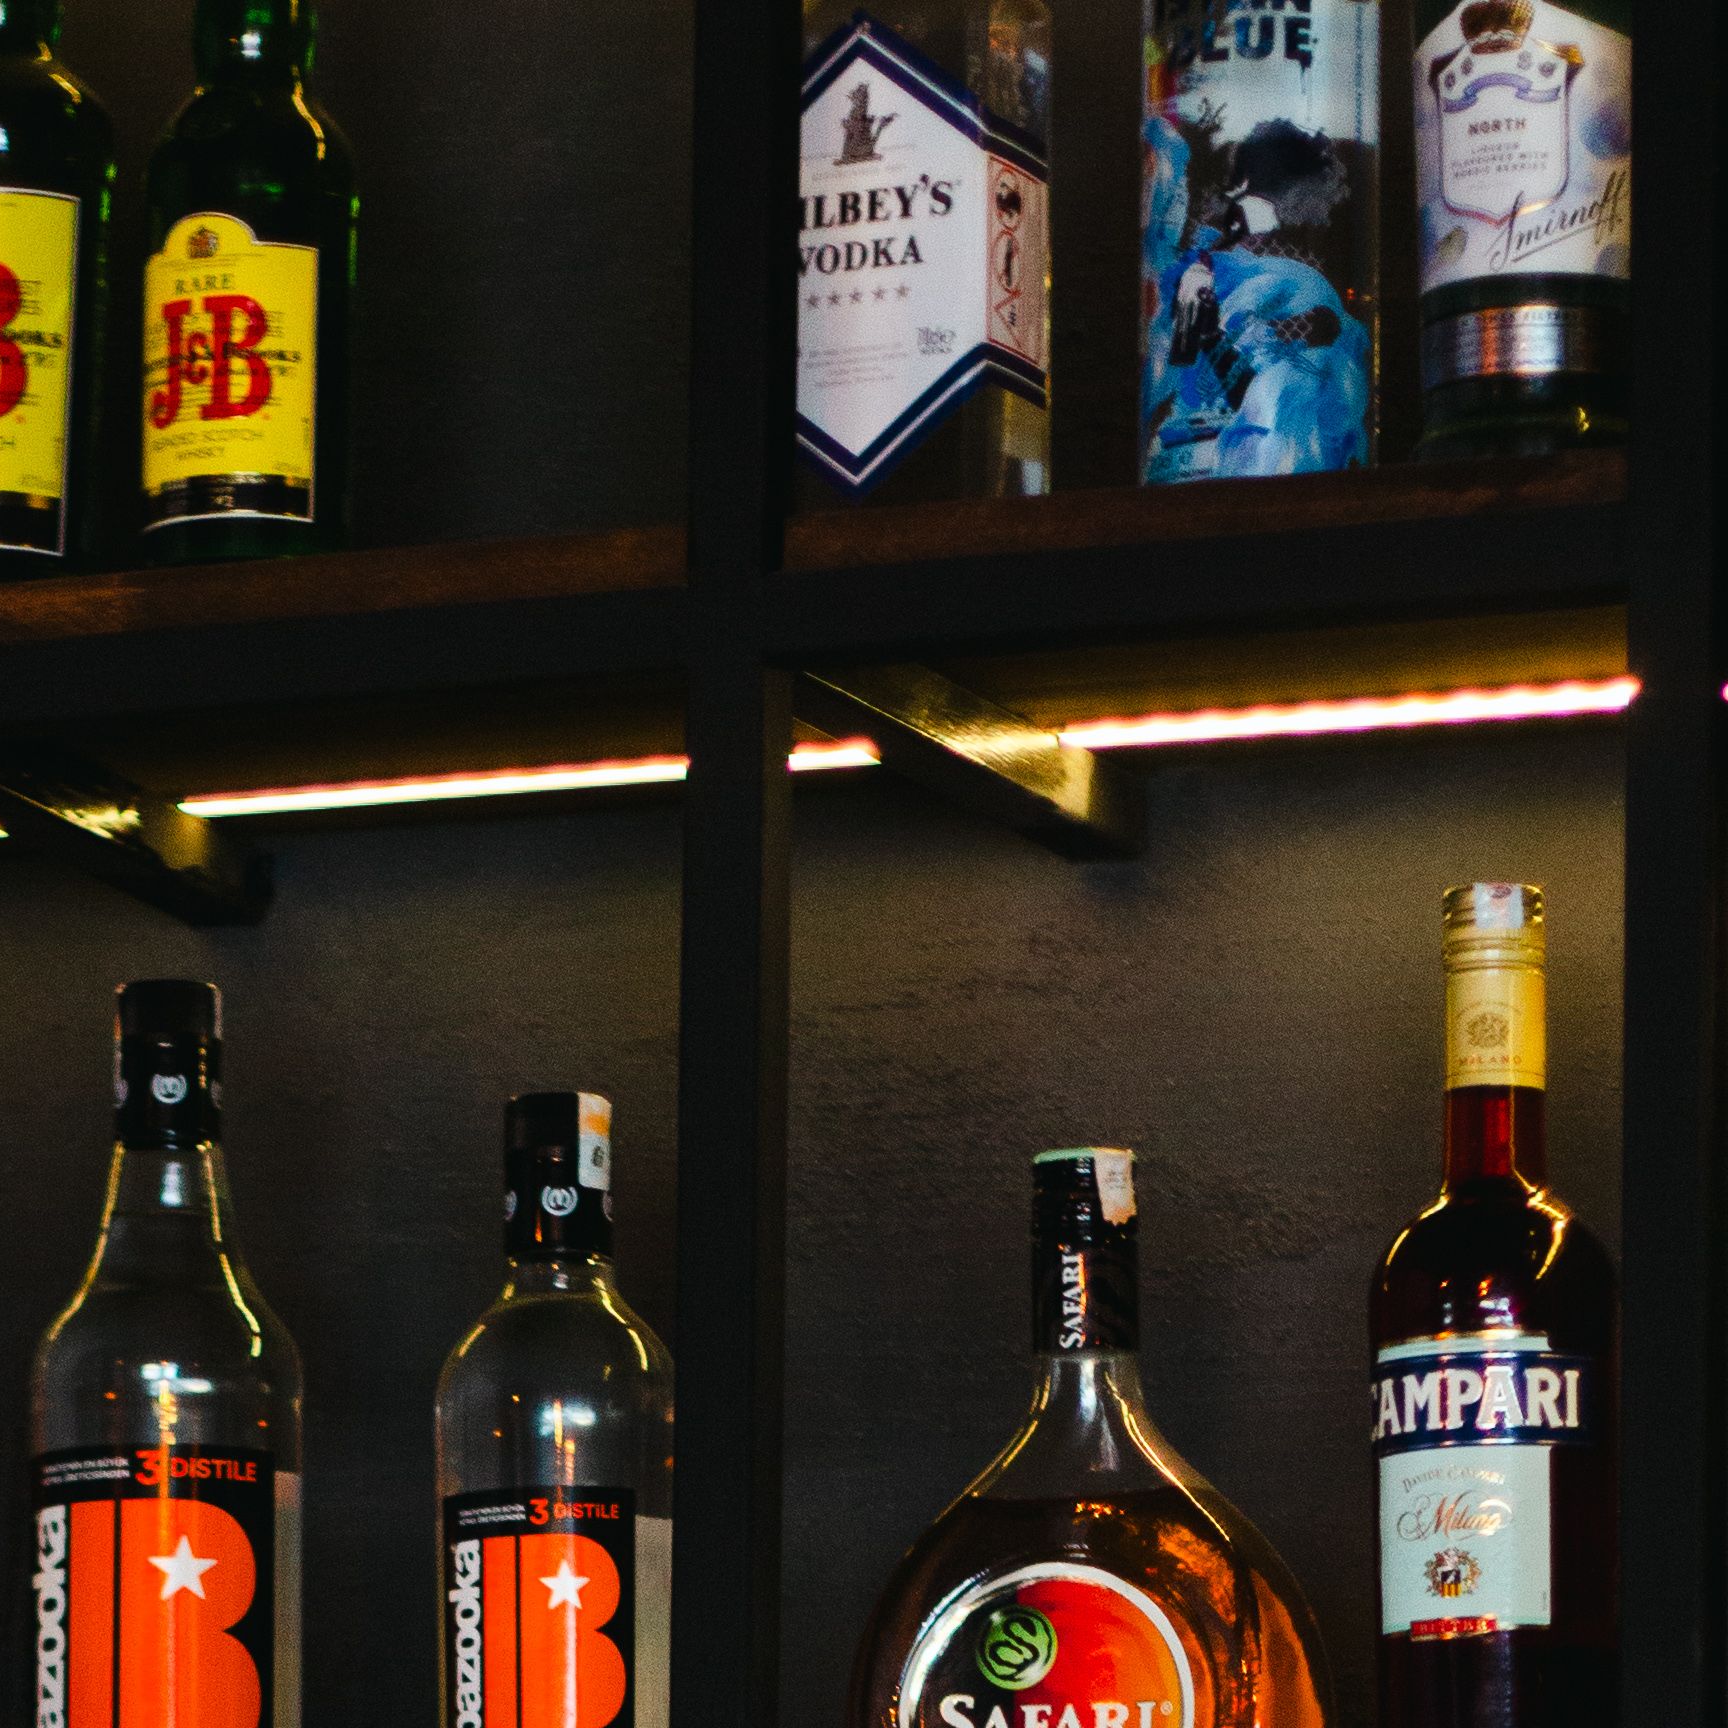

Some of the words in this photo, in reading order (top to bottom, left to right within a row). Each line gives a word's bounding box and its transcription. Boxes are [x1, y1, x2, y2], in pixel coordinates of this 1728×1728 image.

[1467, 117, 1527, 136] NORTH
[799, 173, 953, 232] ILBEY'S
[1489, 171, 1627, 272] Smirnoff
[1059, 1254, 1086, 1349] SAFARI
[1371, 1365, 1582, 1441] AMPARI
[135, 1449, 165, 1486] 3
[528, 1497, 550, 1525] 3
[1398, 1490, 1510, 1542] Milano
